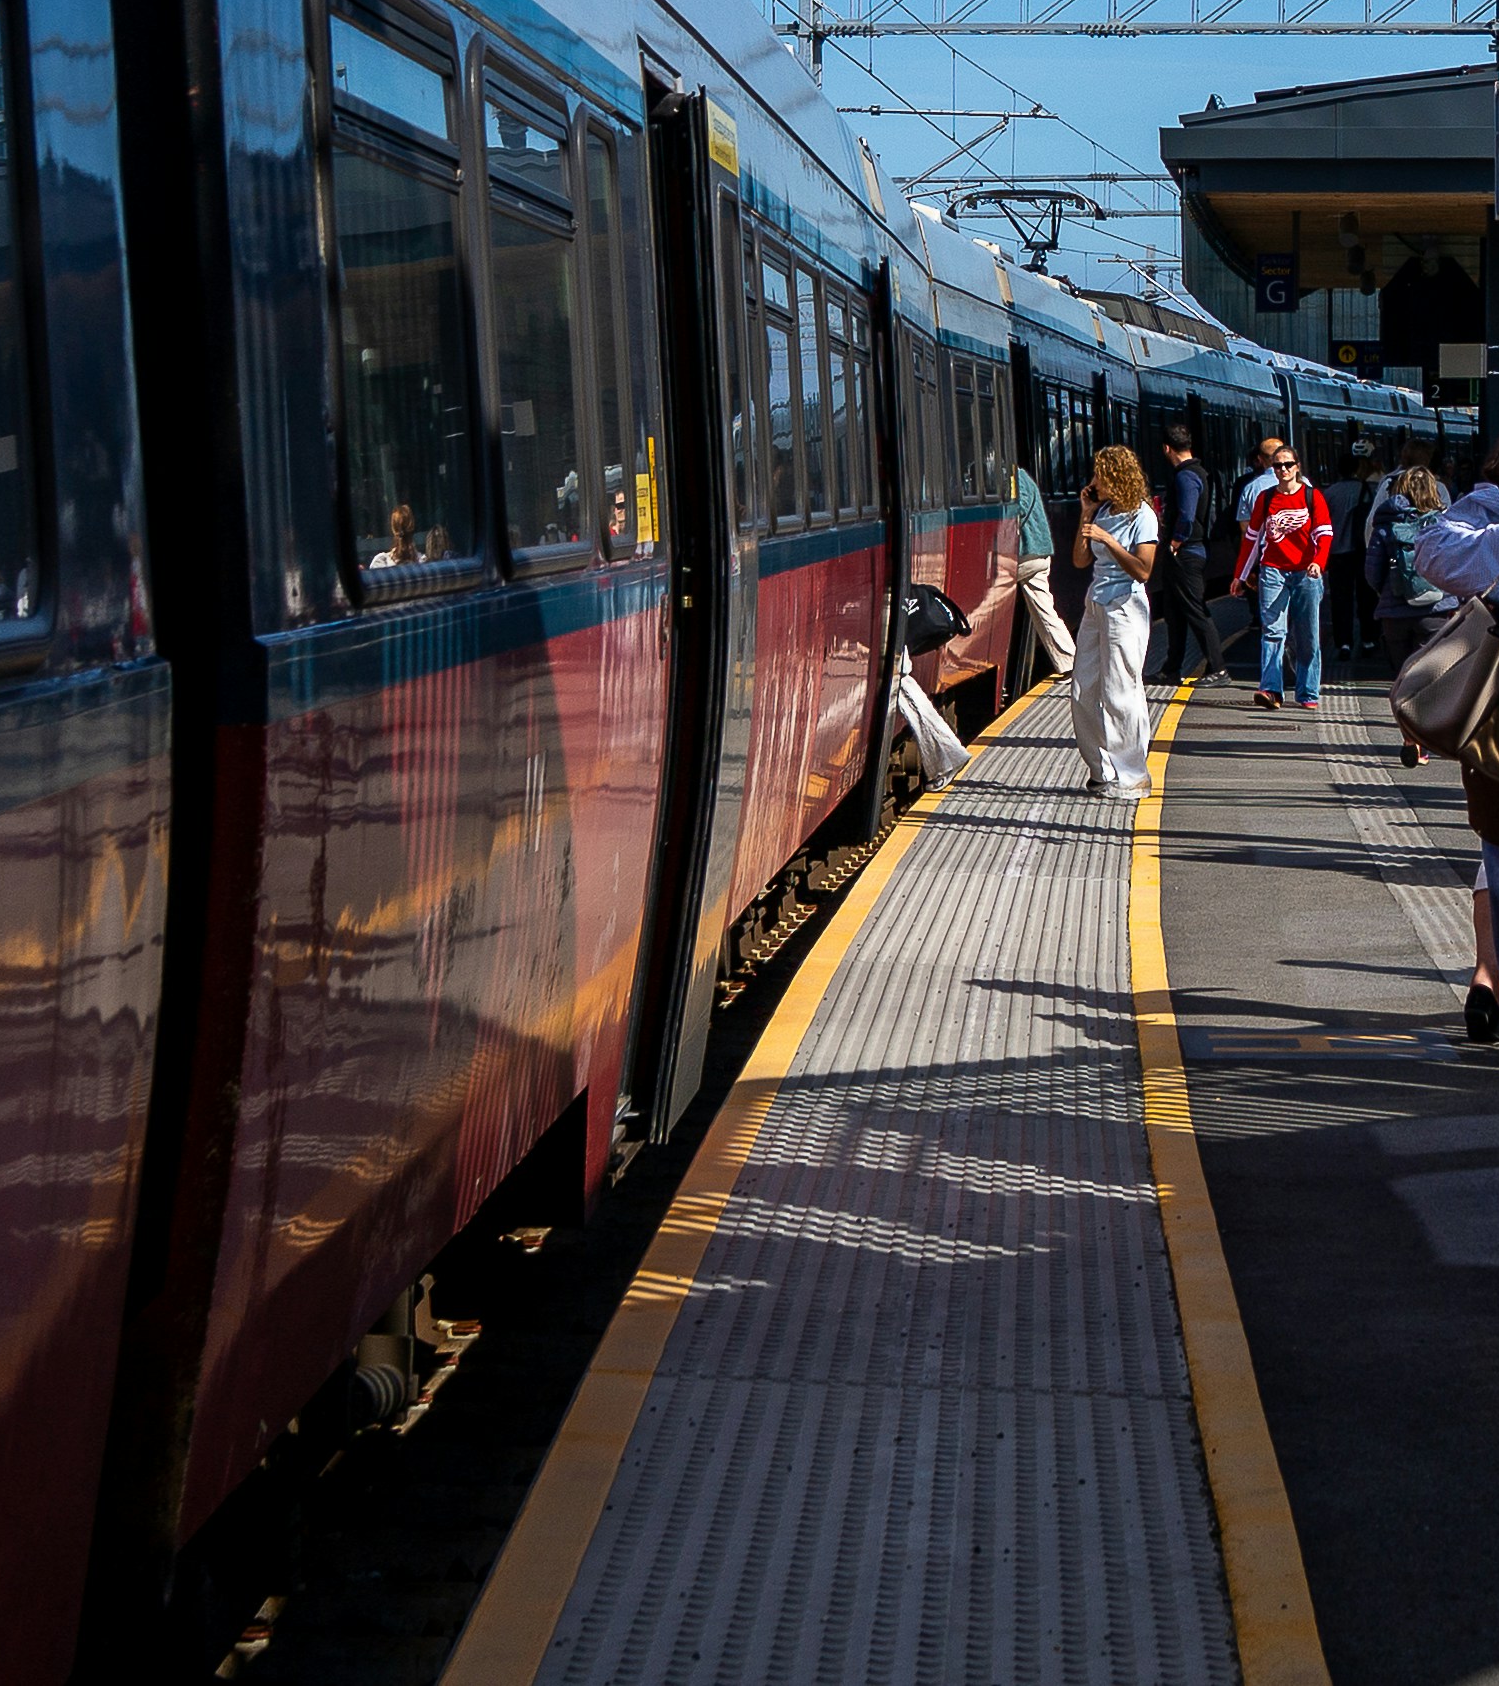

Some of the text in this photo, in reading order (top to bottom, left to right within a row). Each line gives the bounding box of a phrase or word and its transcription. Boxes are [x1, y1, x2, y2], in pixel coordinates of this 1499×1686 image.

[1260, 266, 1293, 276] Sector
[1266, 280, 1286, 304] G
[1431, 384, 1441, 399] 2
